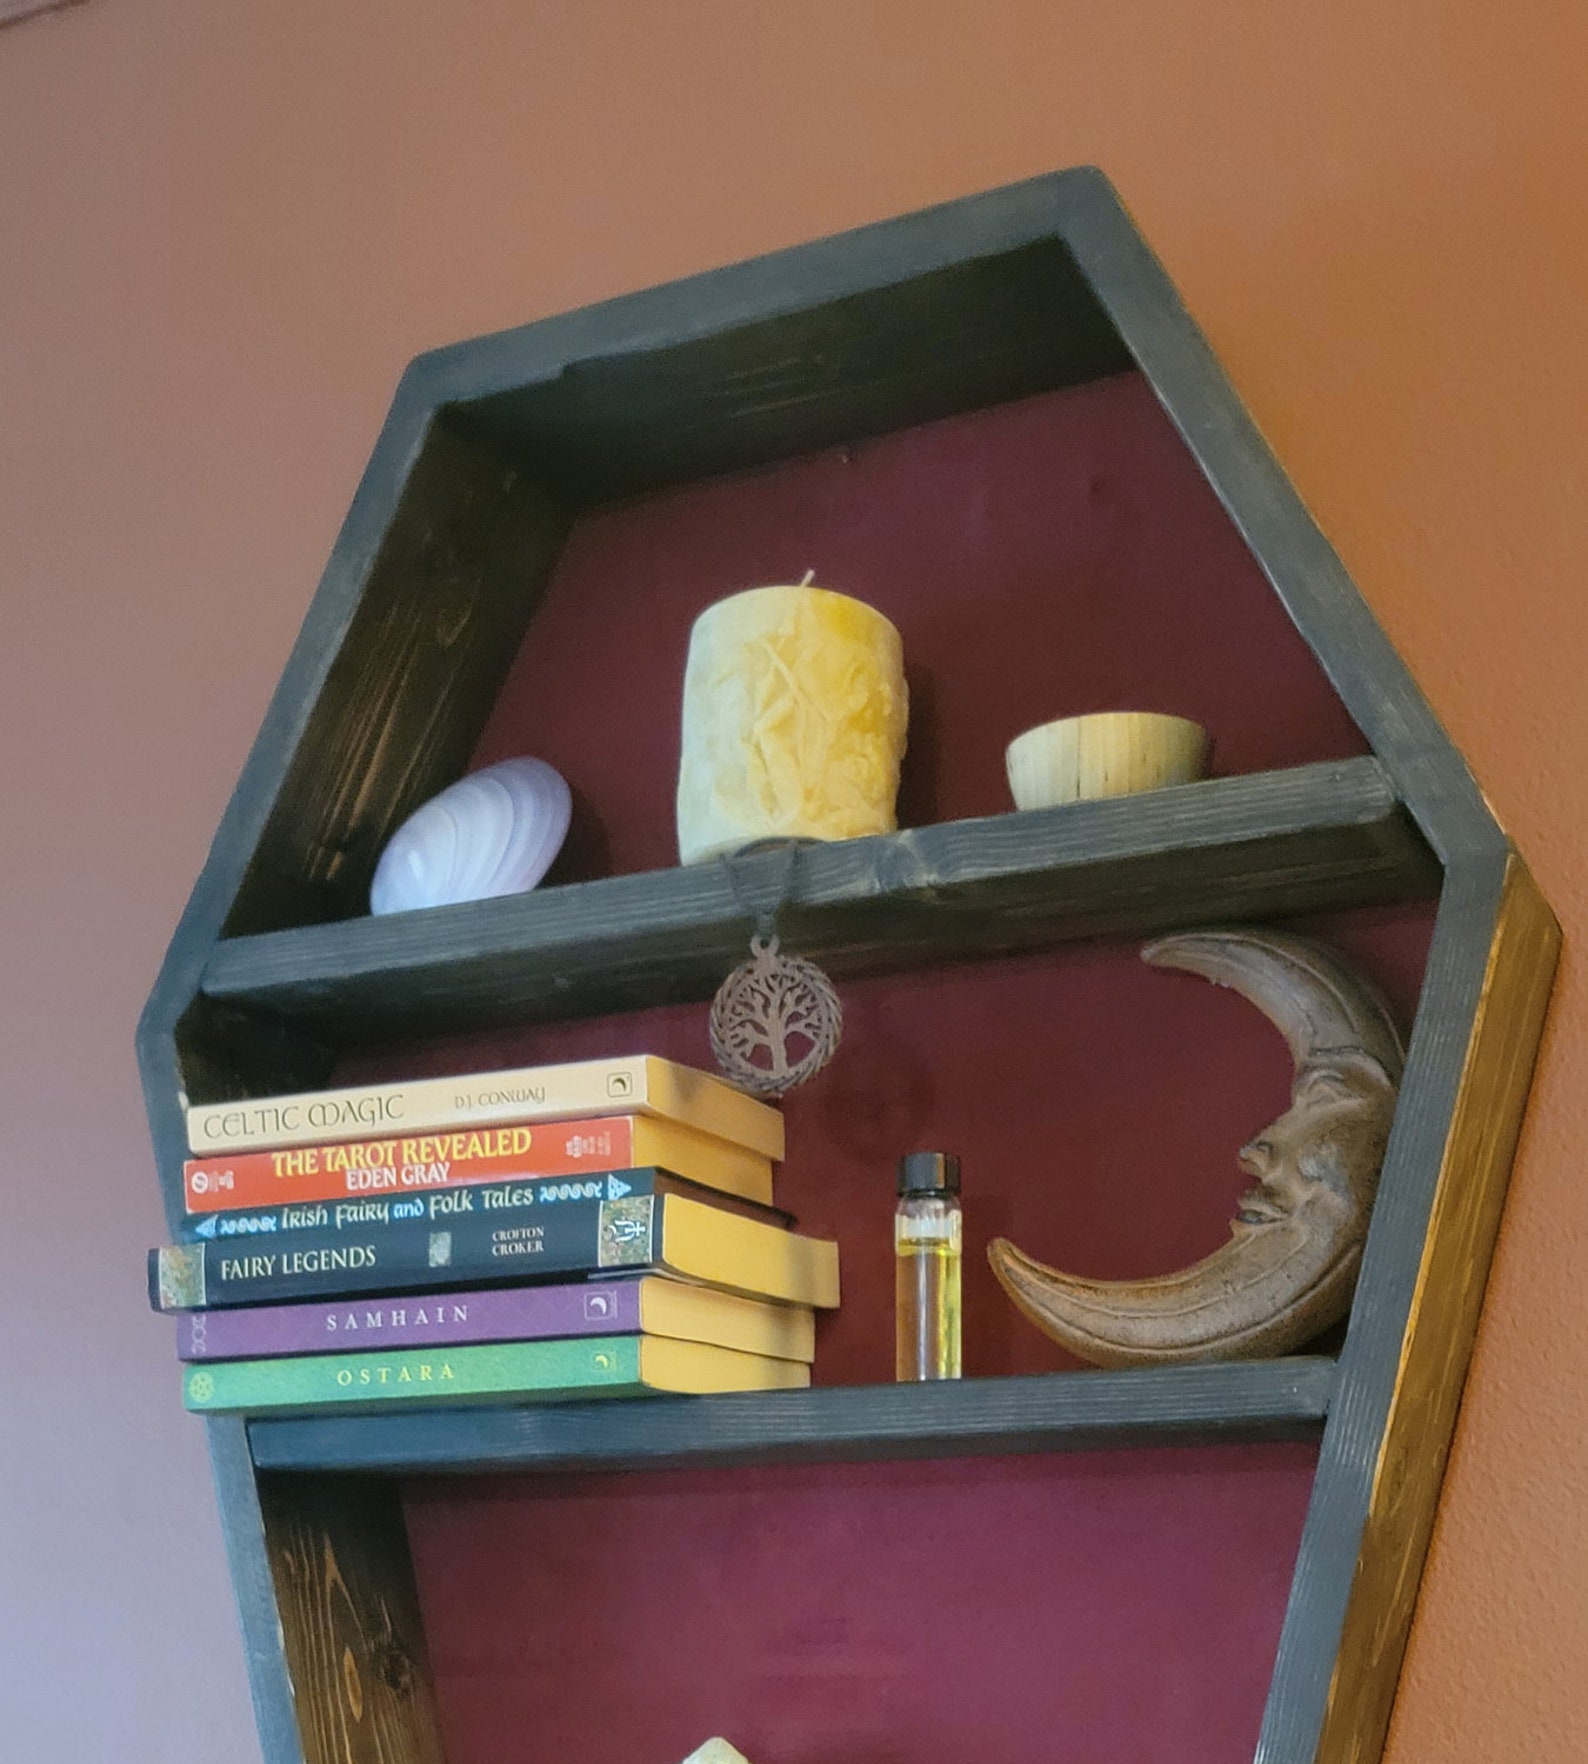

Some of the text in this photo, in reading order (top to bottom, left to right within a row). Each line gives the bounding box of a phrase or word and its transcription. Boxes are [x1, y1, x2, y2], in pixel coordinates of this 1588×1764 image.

[478, 1086, 545, 1106] CONWAY
[203, 1093, 405, 1140] CELTIC MAGIC
[271, 1147, 320, 1177] THE
[321, 1141, 398, 1173] TAROT
[402, 1126, 532, 1166] REVEALED
[346, 1161, 450, 1191] EDEN GRAY
[281, 1185, 534, 1230] Irish Fairy and Folk Tales
[221, 1245, 377, 1281] FAIRY LEGENDS
[492, 1239, 545, 1257] CROKER
[326, 1305, 470, 1332] SAMHAIN
[336, 1364, 454, 1386] OSTARA
